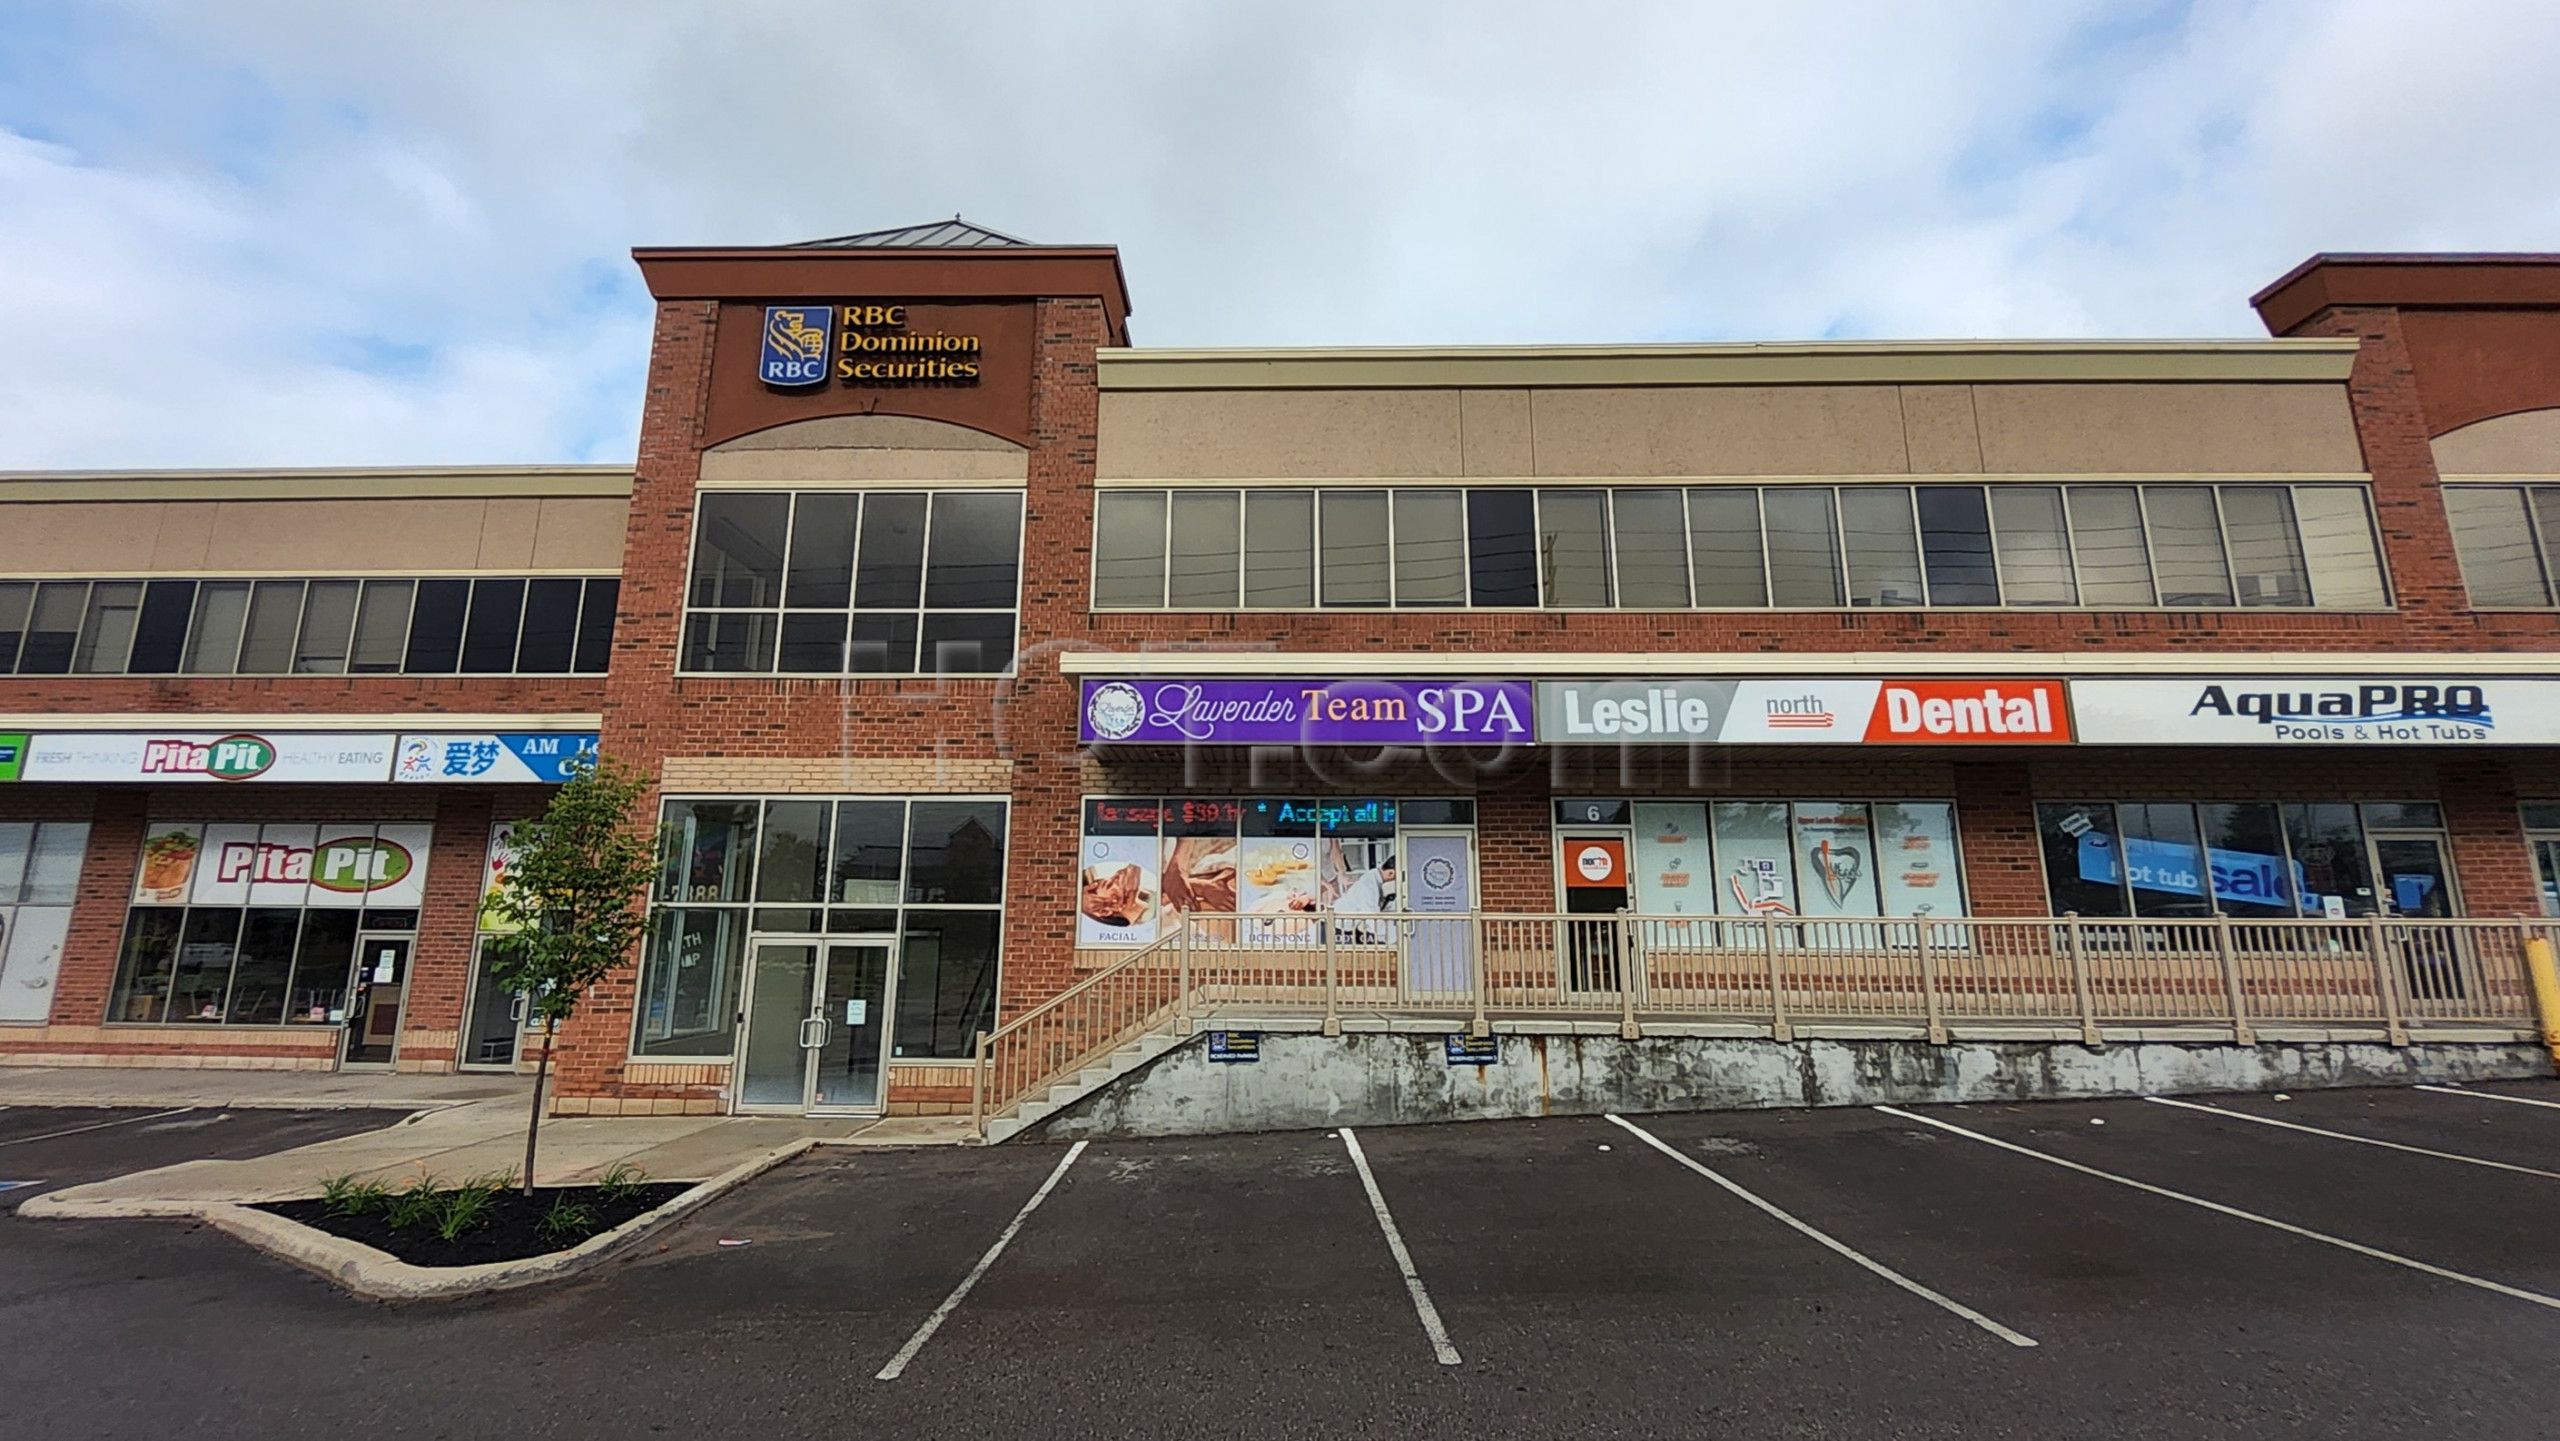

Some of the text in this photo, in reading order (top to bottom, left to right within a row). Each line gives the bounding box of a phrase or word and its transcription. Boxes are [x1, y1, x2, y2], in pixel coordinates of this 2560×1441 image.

[843, 306, 905, 326] RBC
[840, 331, 980, 352] Dominion
[767, 361, 819, 378] RBC
[837, 357, 979, 378] Securities
[1149, 684, 1526, 739] Lavender Team SPA
[1565, 689, 1709, 734] Leslie
[1766, 695, 1824, 714] north
[1886, 688, 2052, 733] Dental
[2189, 685, 2485, 724] AquaPRO
[2275, 725, 2487, 740] Pools & Hot Tubs
[144, 743, 262, 770] Pita Pit
[338, 751, 384, 764] EATING
[522, 739, 560, 755] AM
[442, 740, 500, 776] 爱梦
[1354, 802, 1378, 823] all
[1587, 805, 1600, 822] 6
[221, 847, 390, 881] Pita Pit
[2156, 867, 2198, 888] tub
[1099, 932, 1137, 942] FACIAL
